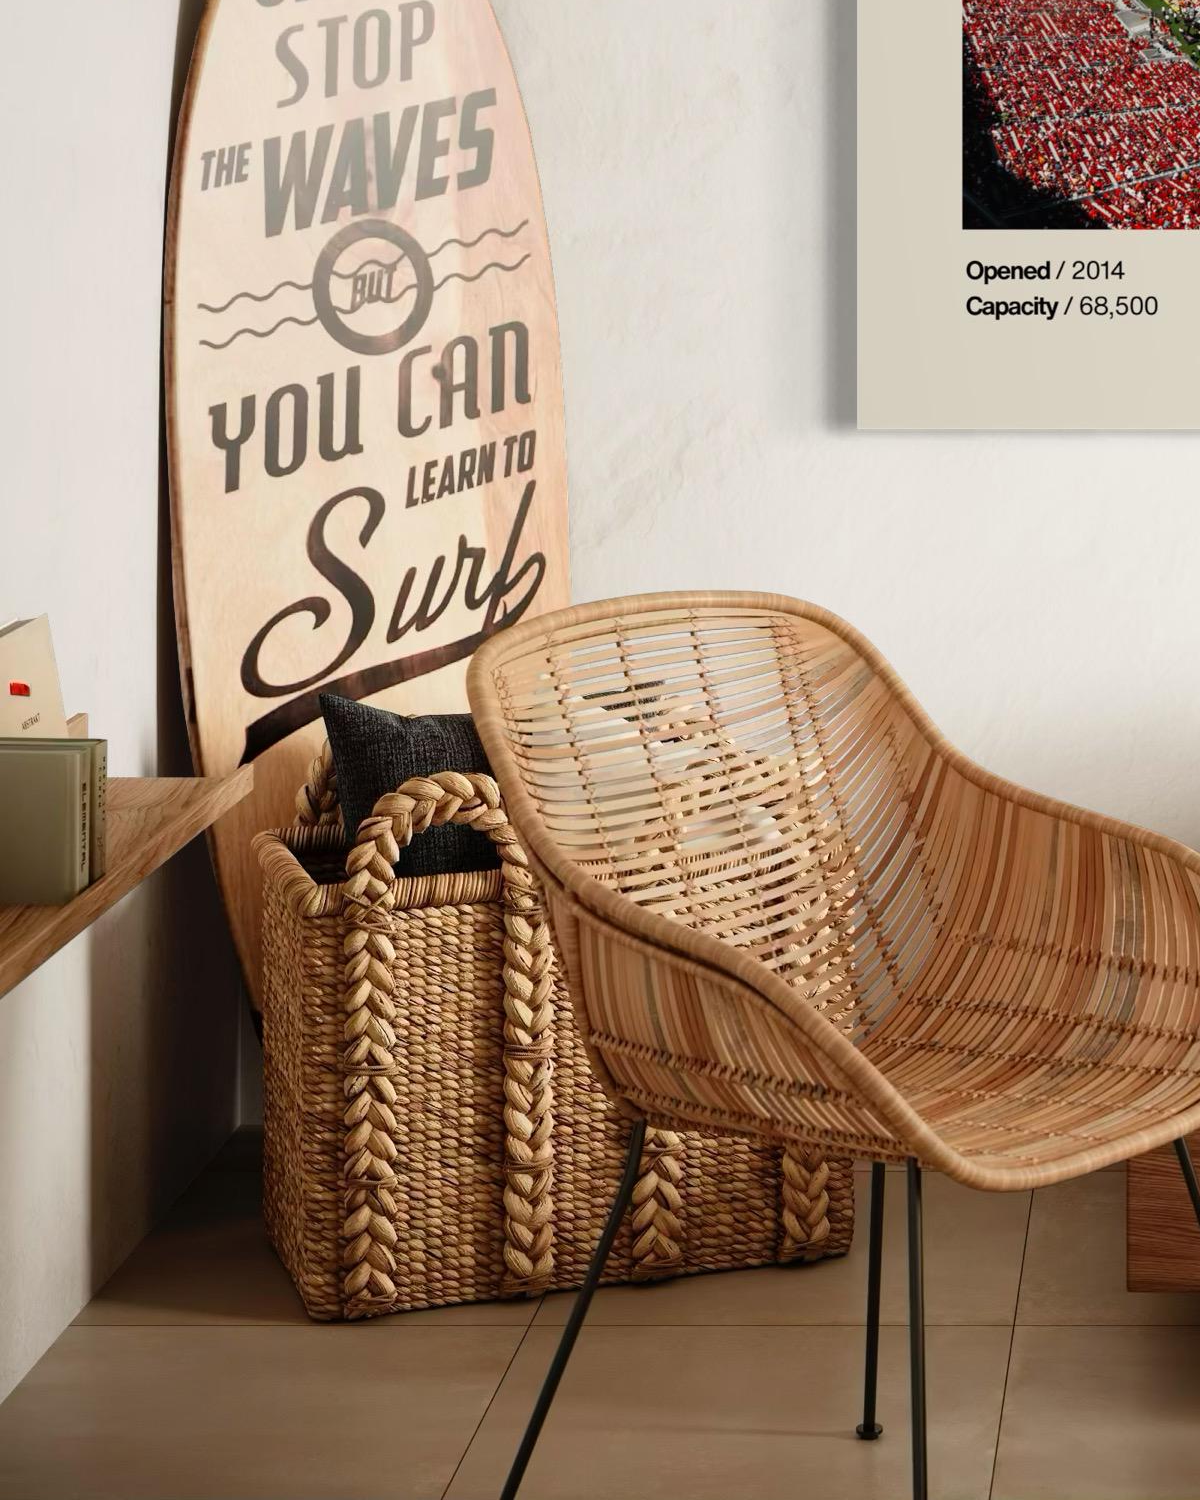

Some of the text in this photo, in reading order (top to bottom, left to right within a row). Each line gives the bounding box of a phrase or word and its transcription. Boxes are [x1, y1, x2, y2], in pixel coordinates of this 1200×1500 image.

[275, 0, 436, 109] STOP
[201, 87, 498, 239] THE WAVES
[350, 263, 398, 311] BUT
[966, 260, 1051, 285] Opened
[1072, 260, 1125, 280] 2014
[966, 296, 1059, 320] Capacity
[1080, 296, 1159, 319] 68,500
[208, 320, 532, 494] YOU CAN
[405, 429, 536, 509] LEARN TO
[240, 479, 547, 698] Surf
